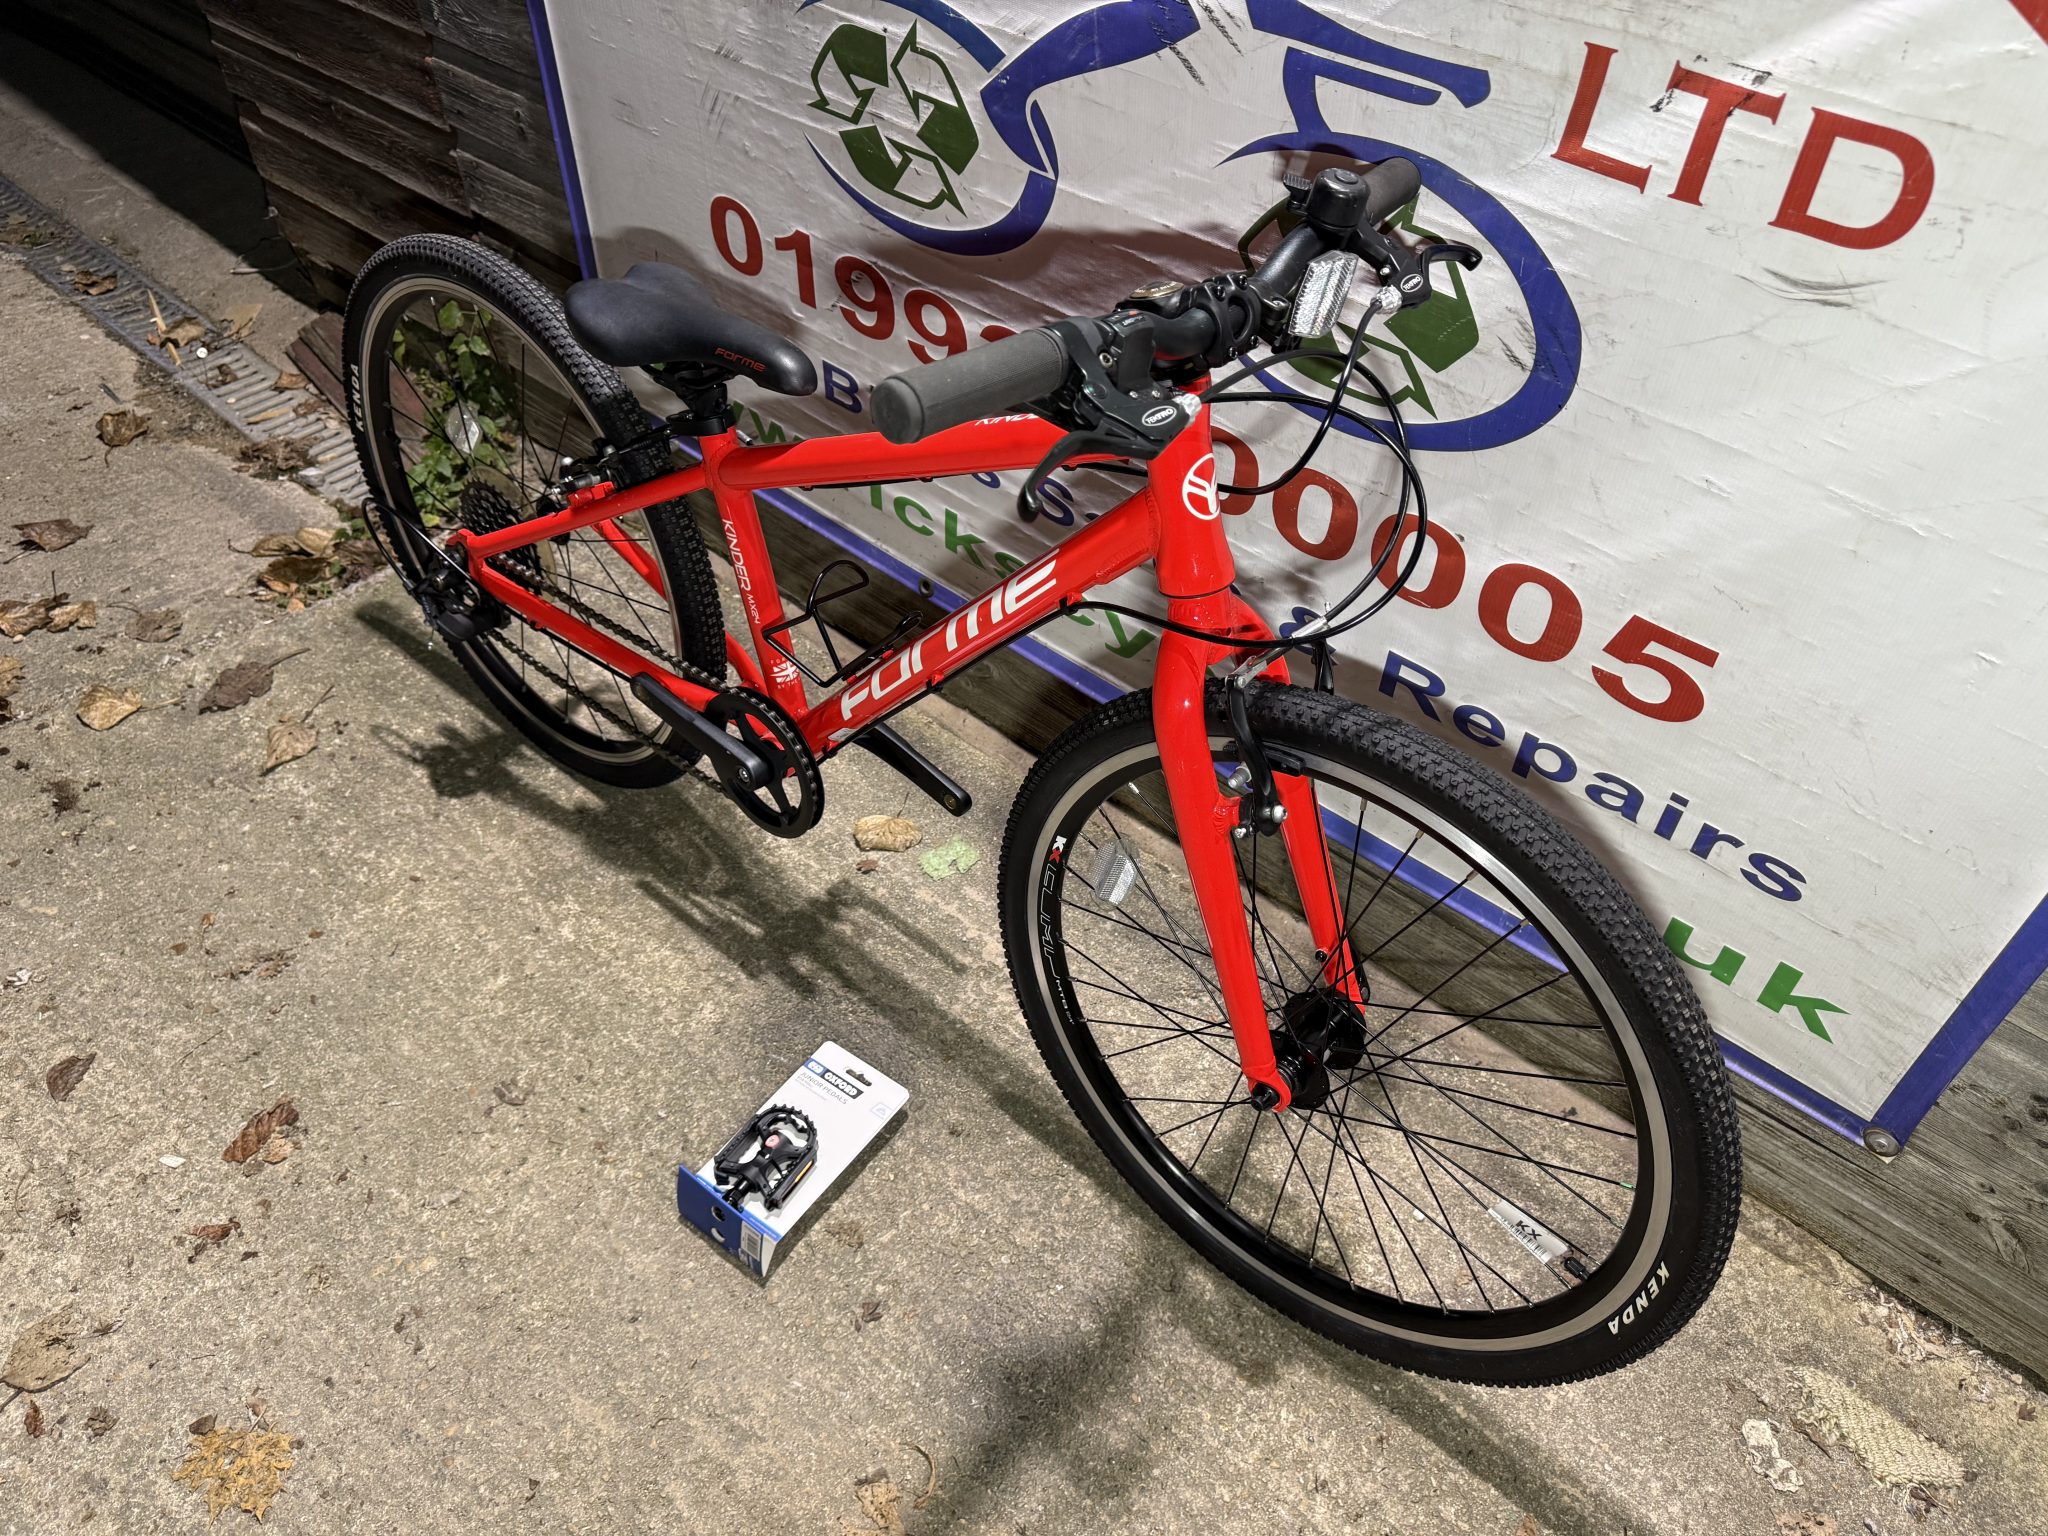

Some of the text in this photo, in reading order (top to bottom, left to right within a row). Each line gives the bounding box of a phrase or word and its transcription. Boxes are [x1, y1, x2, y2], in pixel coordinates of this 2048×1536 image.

[1550, 41, 1936, 250] LTD
[710, 195, 1019, 366] 0199
[350, 363, 365, 433] KENDA
[1145, 408, 1174, 424] TEKTRO
[722, 519, 751, 592] KINDER
[1378, 650, 1808, 903] Repairs
[1050, 835, 1067, 864] KX
[800, 1071, 824, 1089] JUNIOR
[823, 1085, 849, 1105] PEDALS
[824, 1071, 858, 1096] OXFORD
[1515, 1219, 1543, 1241] KX
[1607, 1260, 1671, 1336] KENDA
